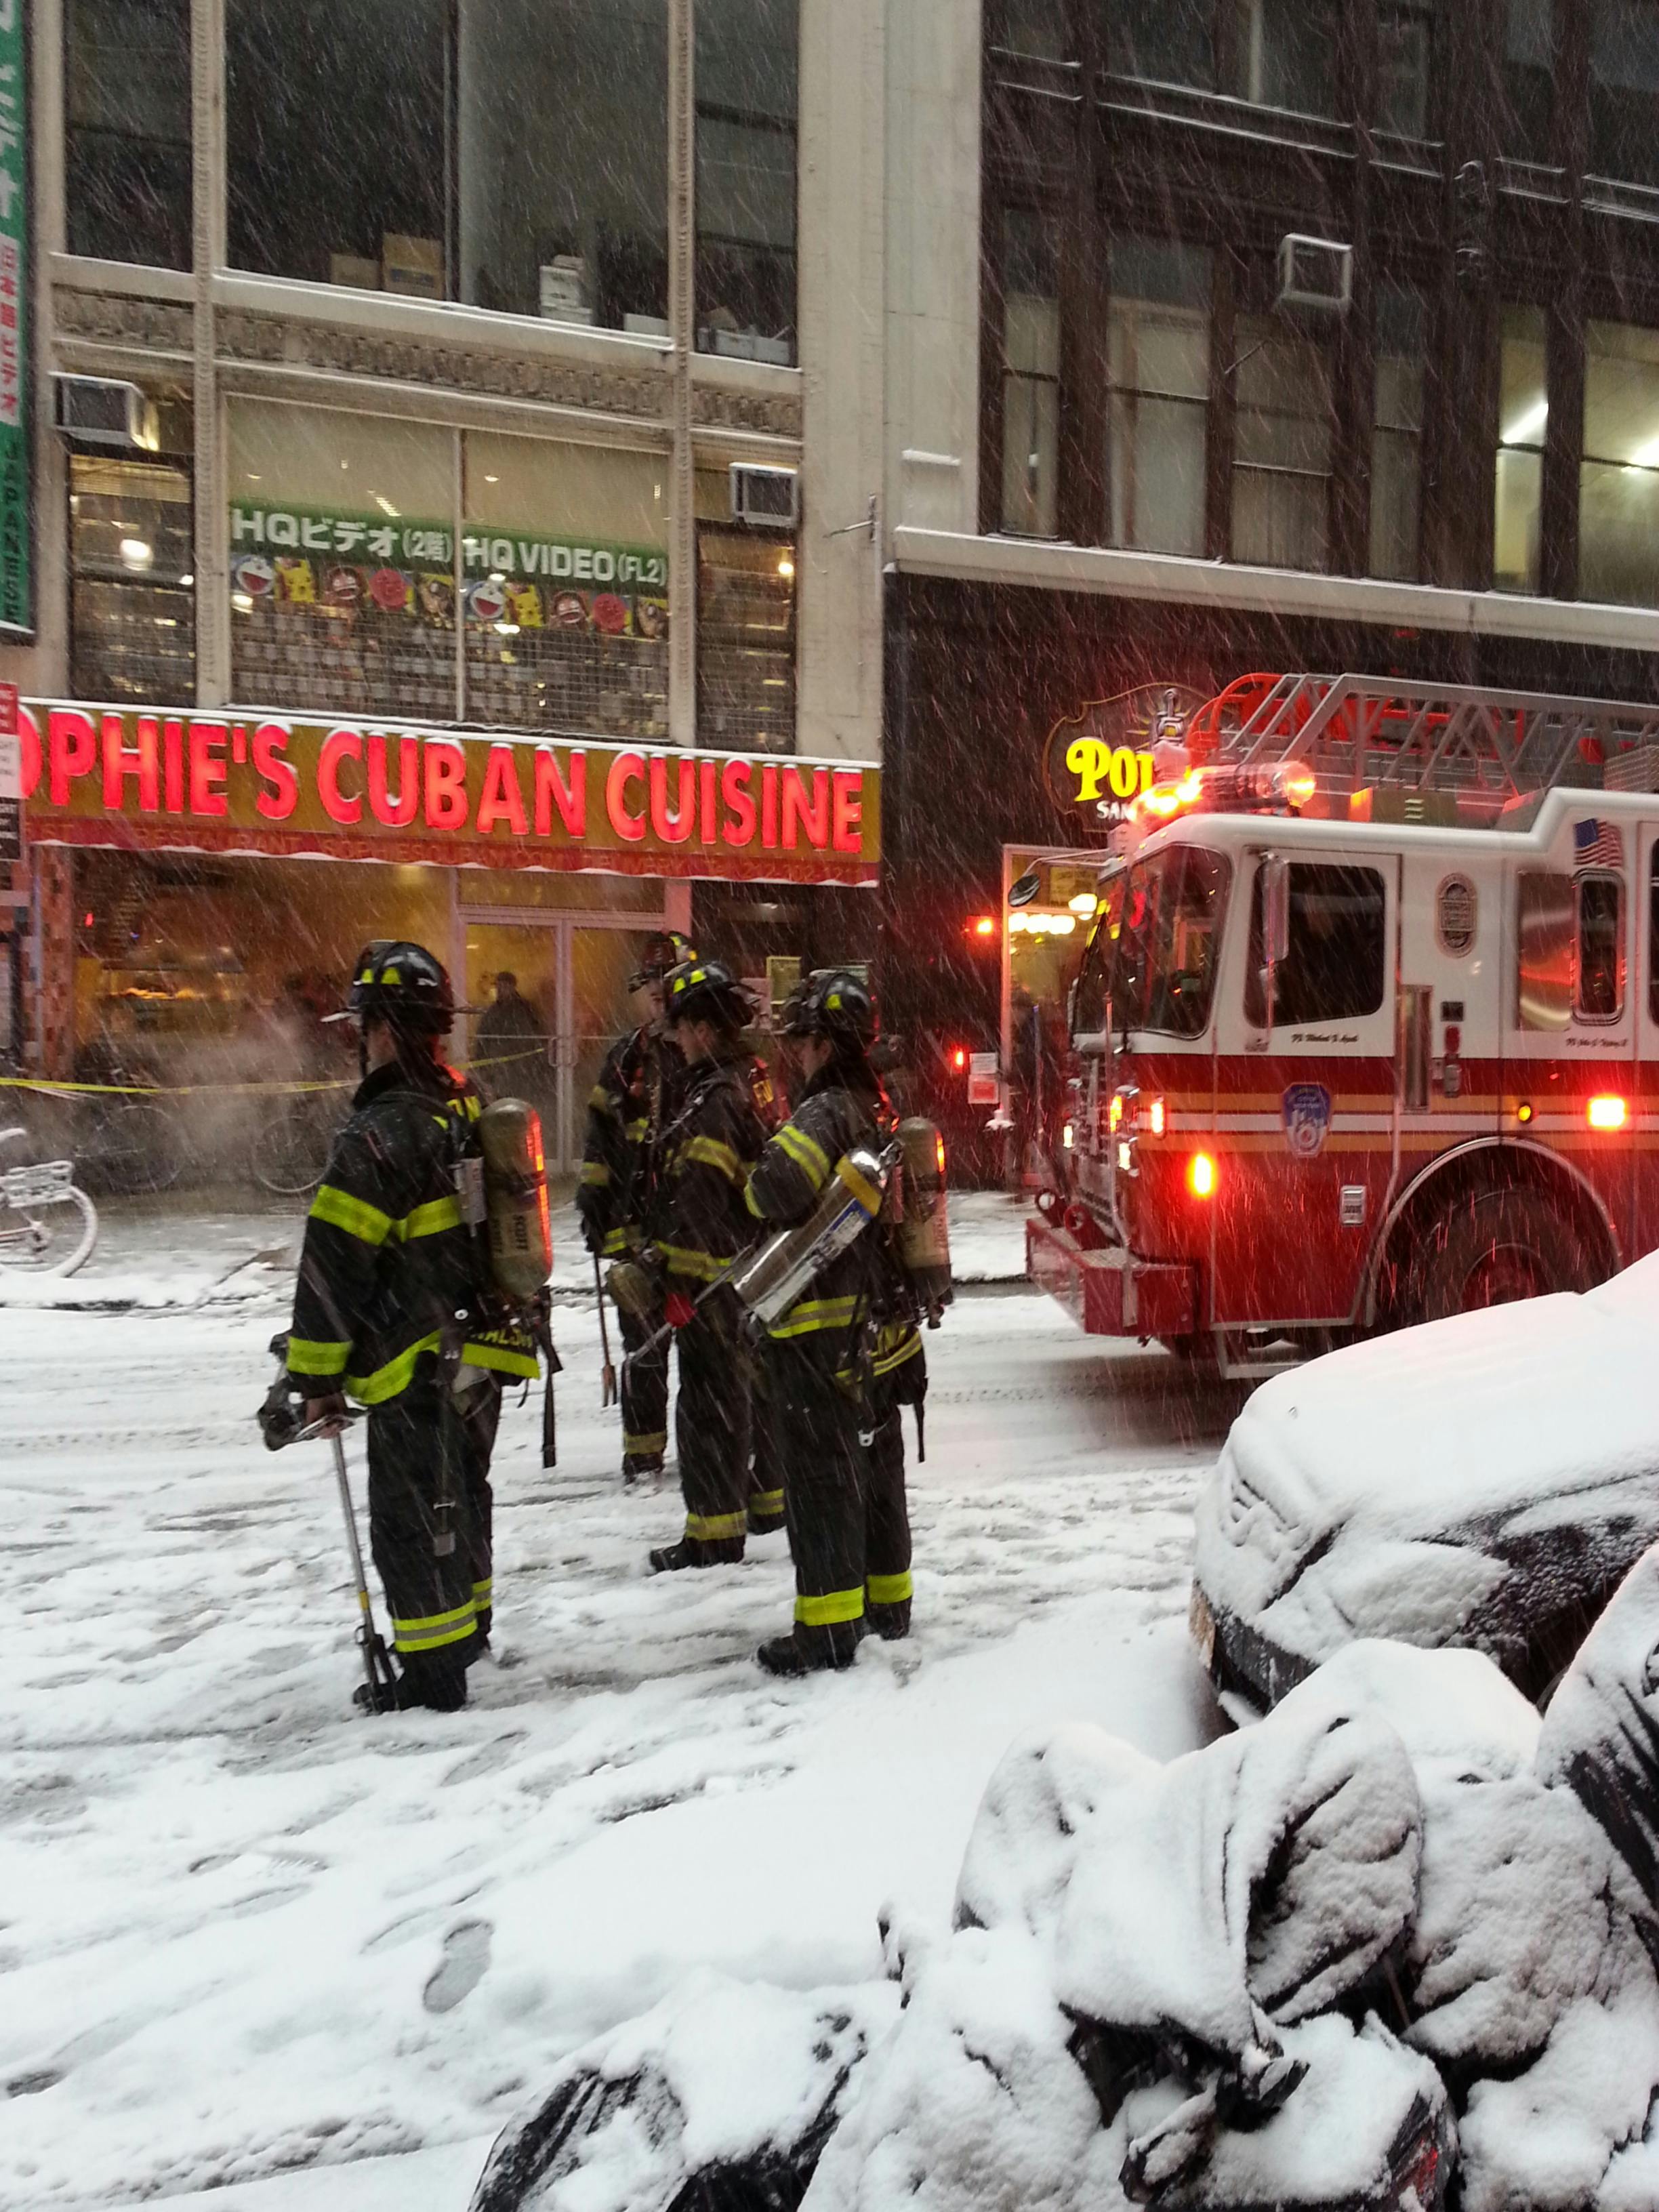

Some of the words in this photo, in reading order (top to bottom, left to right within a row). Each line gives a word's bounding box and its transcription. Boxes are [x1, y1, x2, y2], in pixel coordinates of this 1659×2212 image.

[466, 537, 516, 571] HQ
[317, 729, 586, 838] CUBAN
[606, 752, 863, 853] CUISINE
[133, 827, 302, 854] RESTAURANT
